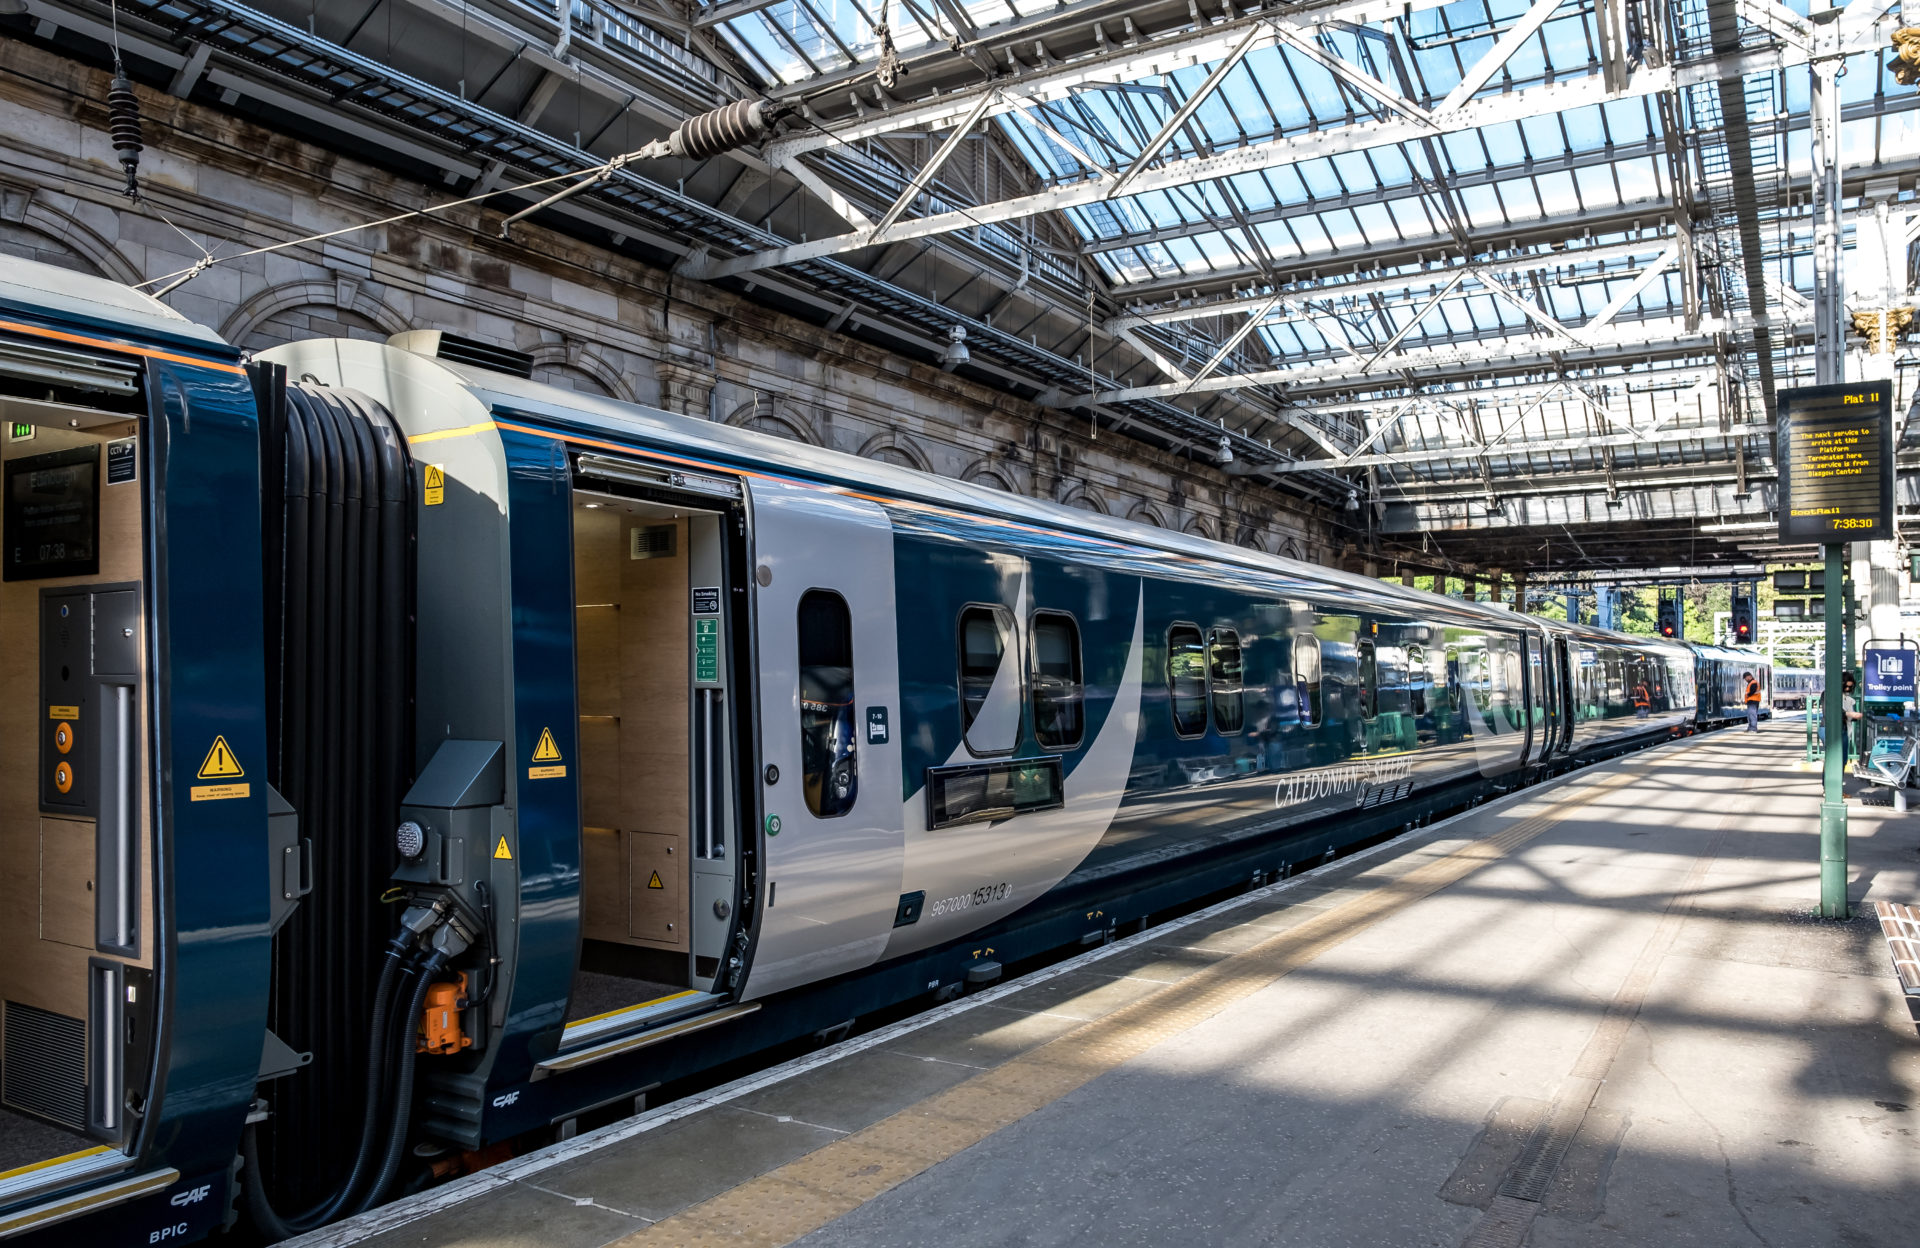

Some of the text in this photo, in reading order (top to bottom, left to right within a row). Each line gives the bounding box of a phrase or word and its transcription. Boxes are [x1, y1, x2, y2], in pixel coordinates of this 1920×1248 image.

[1844, 392, 1879, 404] Plat 11
[110, 445, 123, 456] CCTV
[1832, 518, 1872, 529] 7:38:30
[39, 543, 65, 560] 07:38
[1275, 756, 1413, 809] CALEDONIAN SLEEPER
[492, 1090, 520, 1108] CAF
[170, 1184, 211, 1207] CAF
[149, 1222, 188, 1244] BPIC
